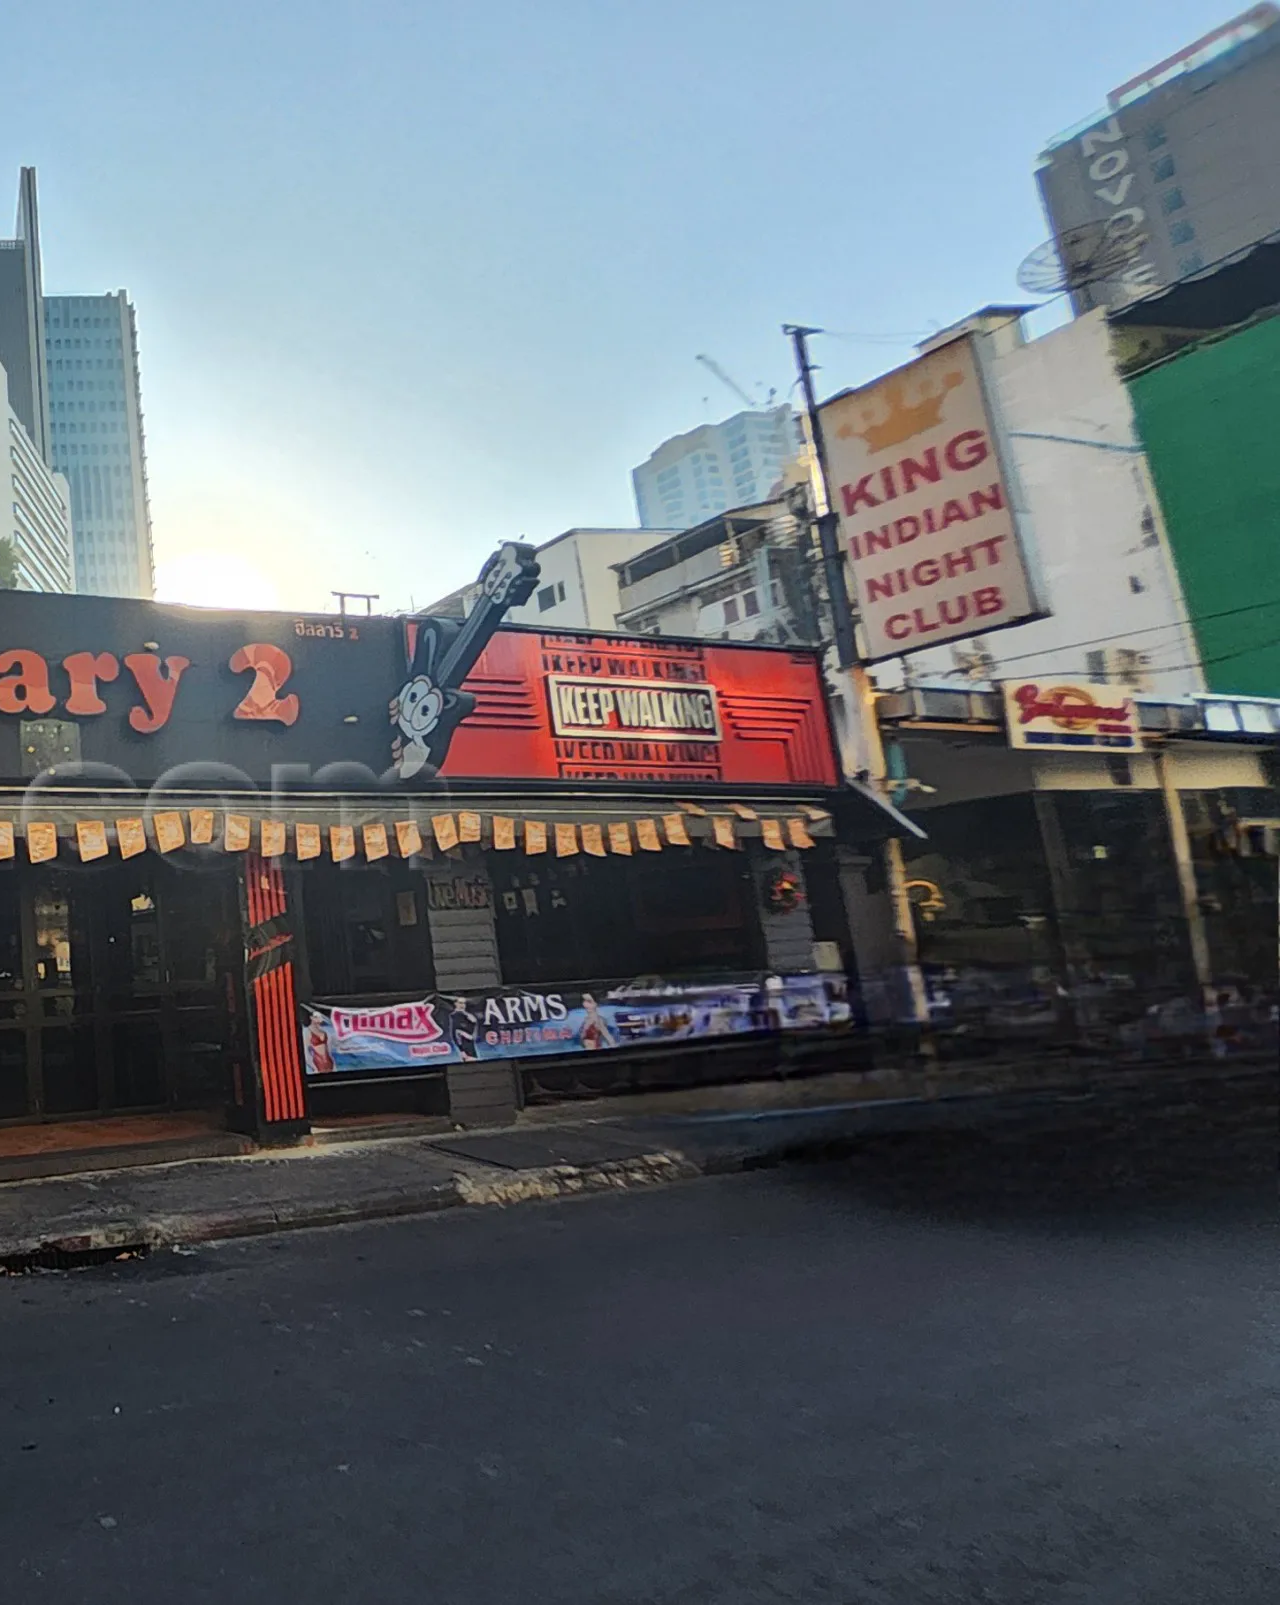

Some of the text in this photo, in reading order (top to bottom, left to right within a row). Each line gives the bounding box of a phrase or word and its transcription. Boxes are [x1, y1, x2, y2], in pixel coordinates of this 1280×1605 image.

[840, 429, 988, 517] KING
[848, 483, 1007, 561] INDIAN
[865, 534, 1007, 604] NIGHT
[884, 585, 1005, 641] CLUB
[228, 642, 300, 727] 2
[558, 686, 713, 730] KEEP WALKING
[332, 1003, 441, 1042] Climax
[483, 993, 568, 1025] ARMS
